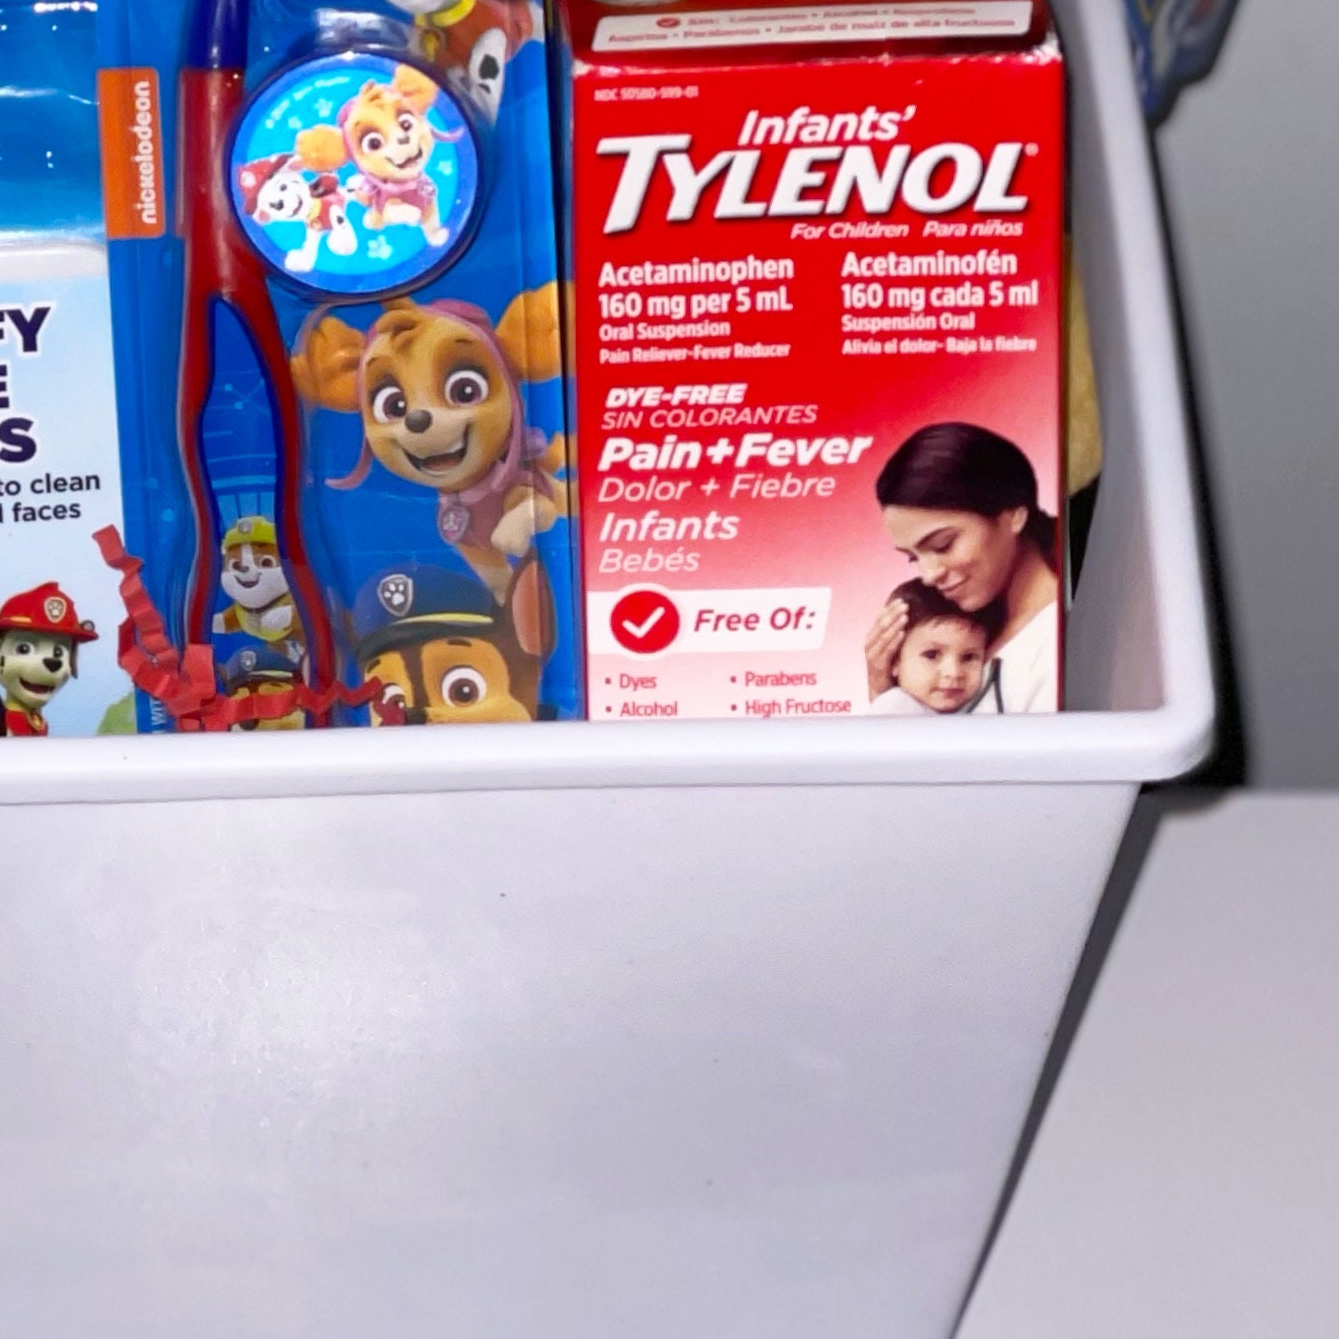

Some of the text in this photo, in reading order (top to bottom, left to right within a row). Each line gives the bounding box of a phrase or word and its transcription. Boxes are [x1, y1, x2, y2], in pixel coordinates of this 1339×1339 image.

[129, 80, 158, 224] nickelodeon
[596, 133, 1030, 235] TYLENOL
[790, 220, 910, 240] For Children
[921, 218, 1024, 238] Para niños
[598, 254, 794, 288] Acetaminophen
[840, 248, 1018, 278] Acetaminofén
[598, 285, 794, 320] 160 mg per 5 mL
[840, 278, 1039, 312] 160 mg cada 5 ml
[598, 318, 732, 342] Oral Suspension
[840, 311, 976, 335] Suspensión Oral
[599, 347, 630, 364] Pain
[733, 341, 792, 359] Reducer
[605, 383, 749, 409] DYE-FREE
[600, 403, 819, 431] SIN COLORANTES
[29, 472, 101, 496] clean
[597, 476, 692, 503] Dolor
[729, 472, 837, 499] Fiebre
[11, 501, 82, 523] faces
[598, 509, 742, 542] Infants
[598, 546, 702, 574] Bebés
[693, 606, 816, 632] Free Of:
[619, 673, 658, 692] Dyes
[744, 670, 818, 687] Parabens
[619, 700, 679, 718] Alcohol
[744, 698, 853, 719] High Fructose
